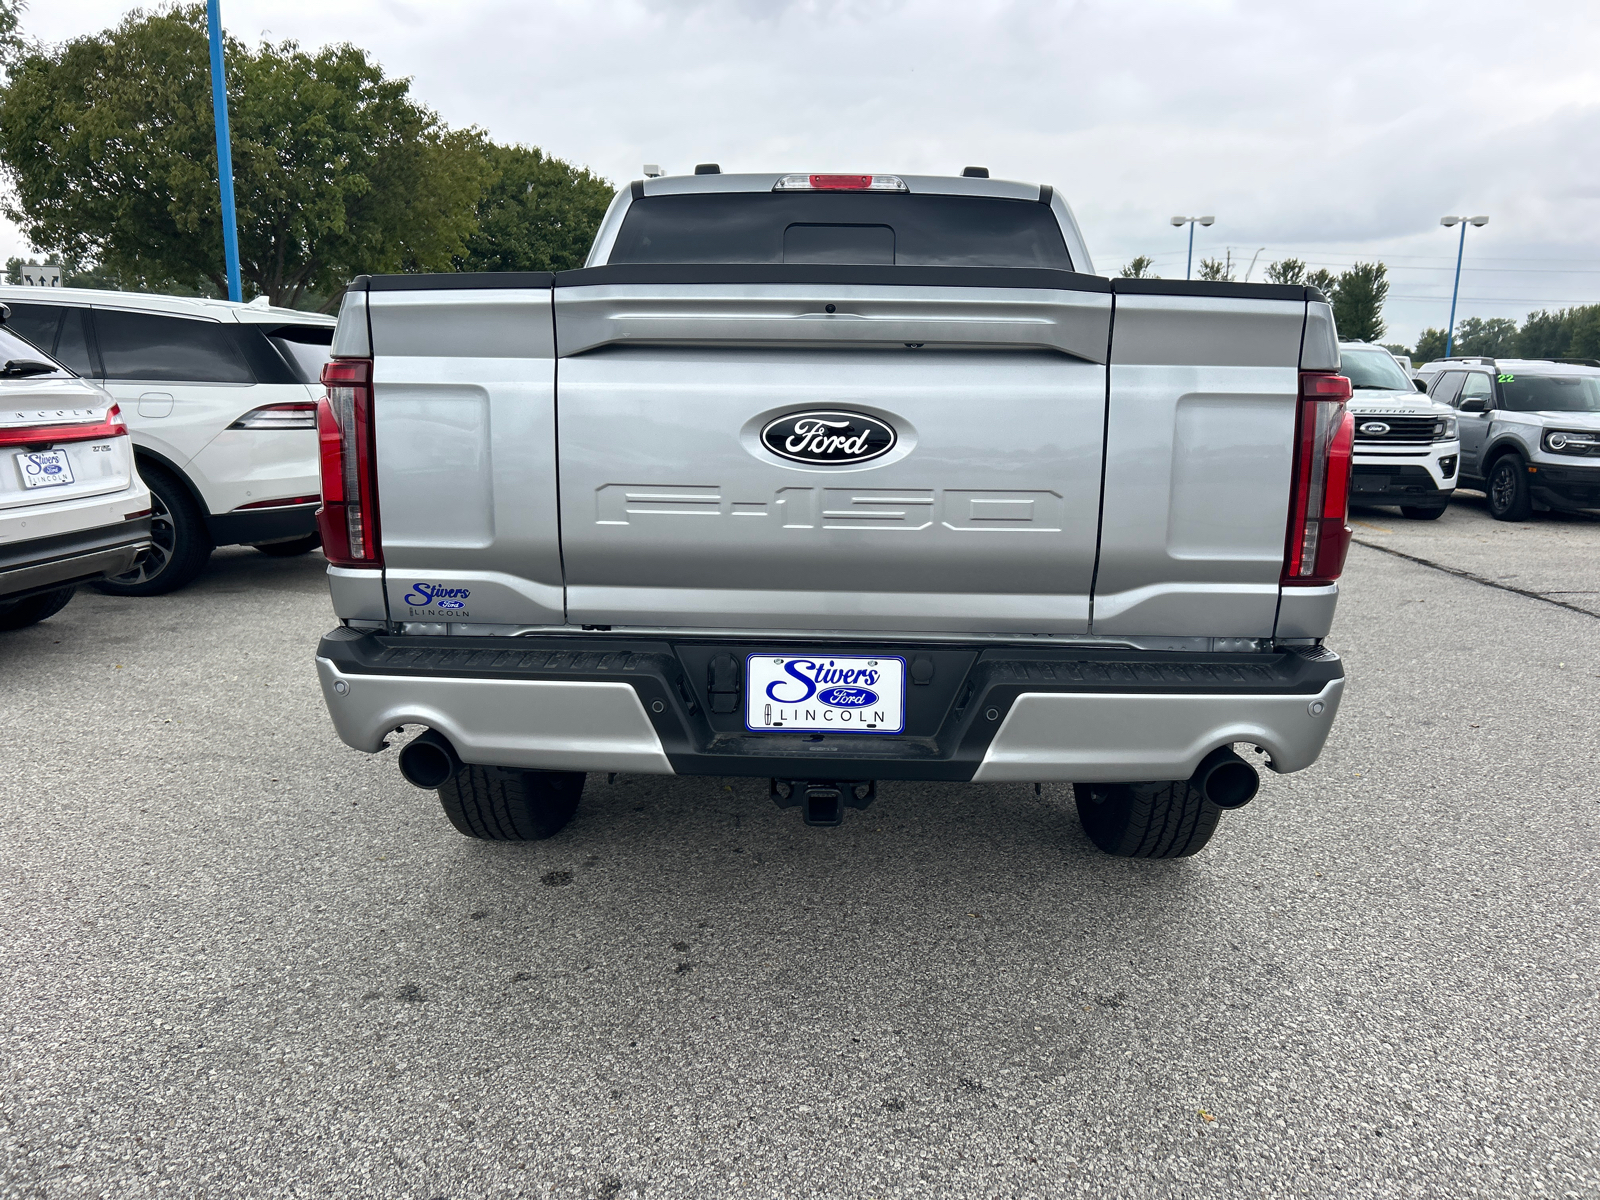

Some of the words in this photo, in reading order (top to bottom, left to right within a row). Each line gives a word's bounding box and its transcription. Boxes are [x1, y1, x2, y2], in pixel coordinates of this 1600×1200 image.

[1497, 374, 1515, 383] 22
[785, 418, 870, 455] Ford
[26, 453, 60, 476] Stivers
[33, 473, 68, 484] LINCOLN
[595, 483, 1064, 532] F-150
[404, 582, 471, 607] Stivers
[414, 608, 470, 617] LINCOLN
[442, 600, 460, 608] Ford
[765, 659, 881, 704] Stivers
[829, 688, 867, 705] Ford
[780, 709, 885, 723] LINCOLN
